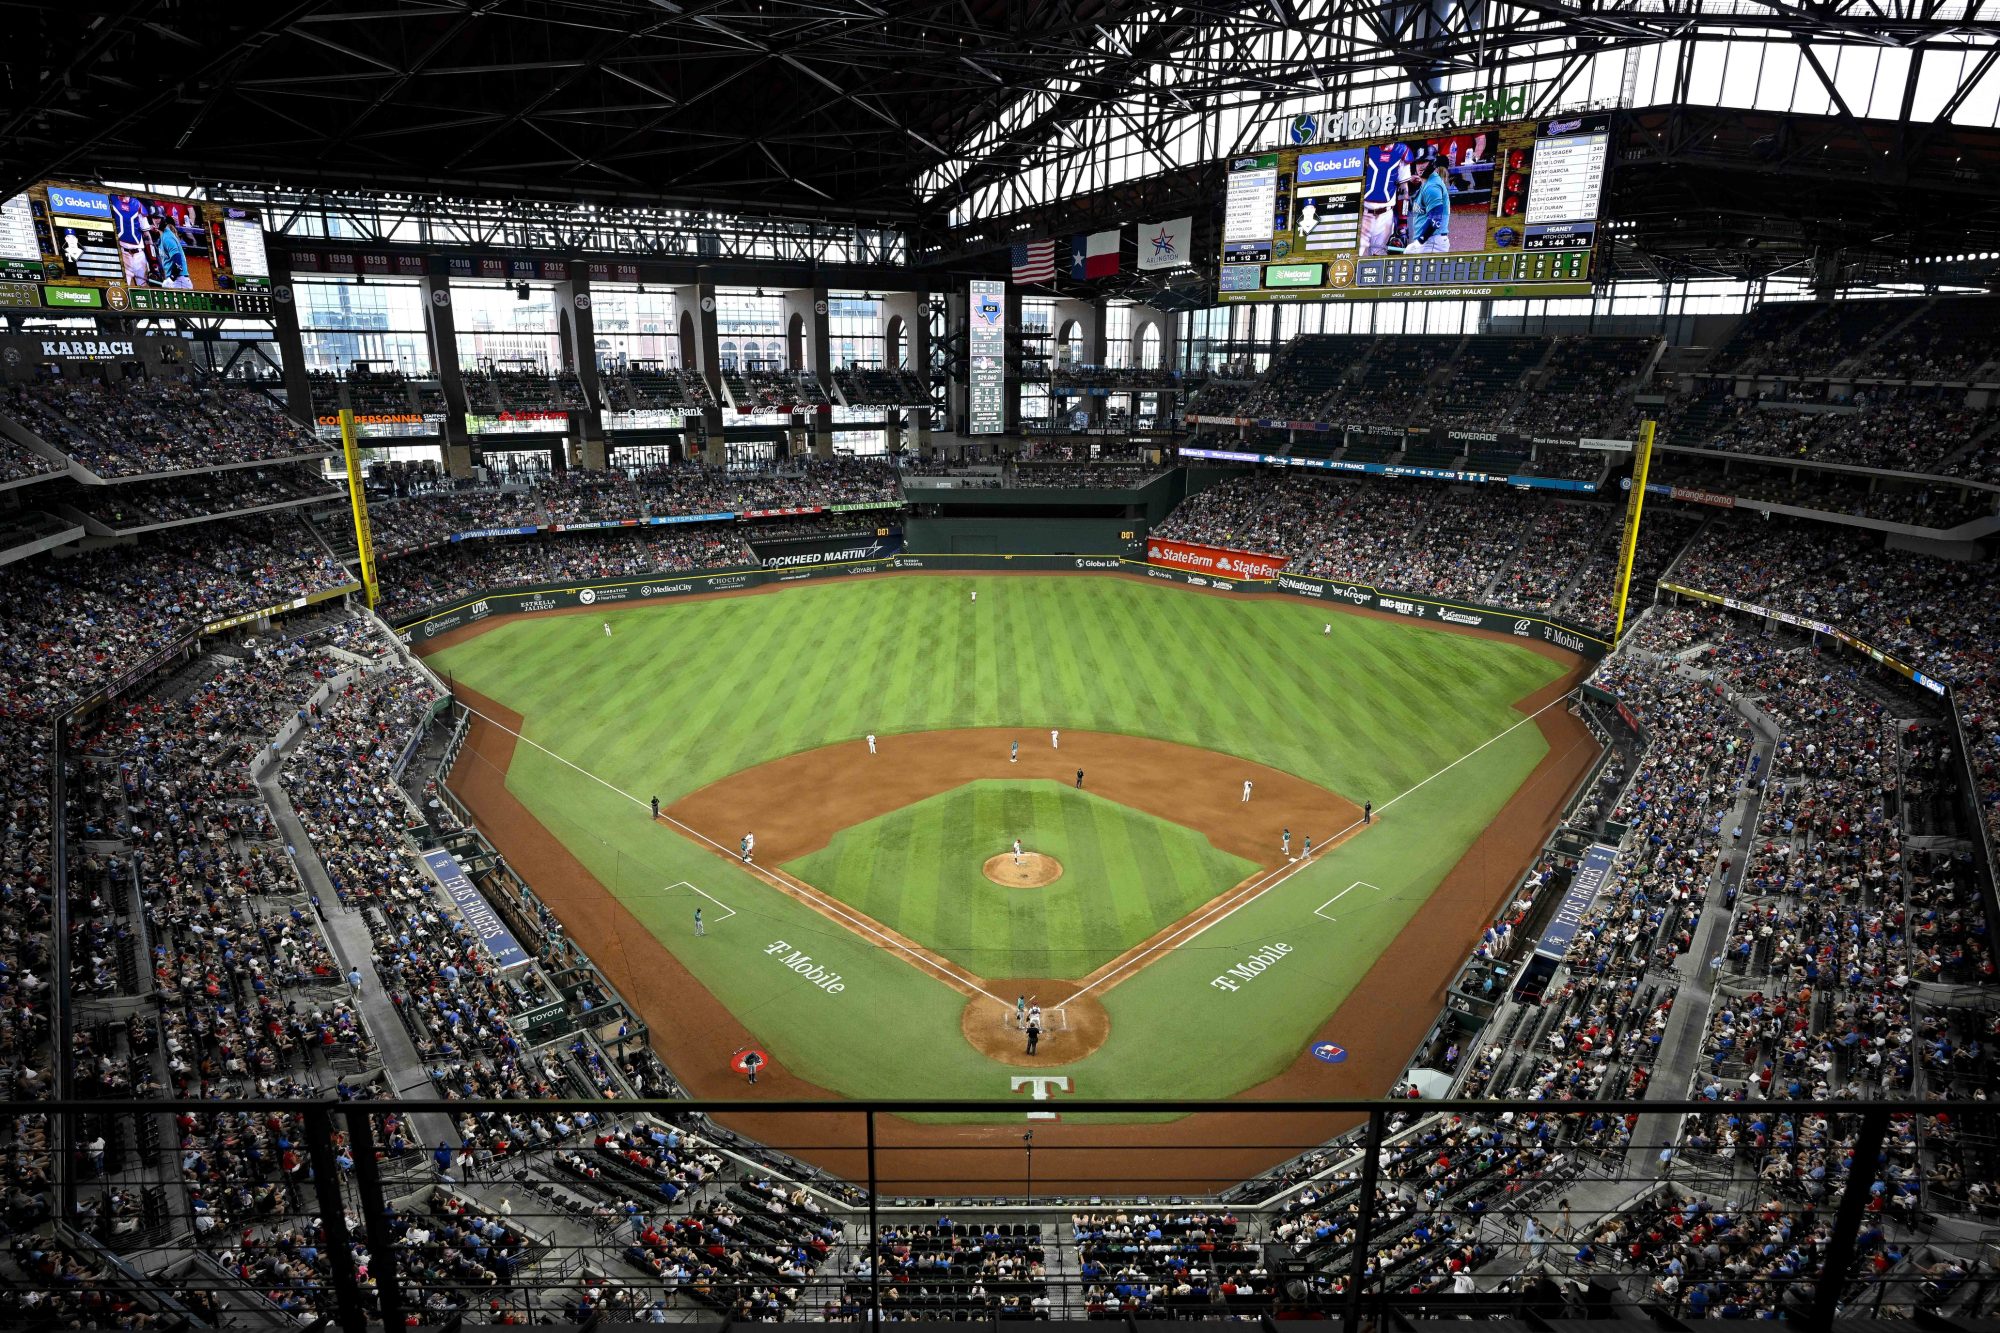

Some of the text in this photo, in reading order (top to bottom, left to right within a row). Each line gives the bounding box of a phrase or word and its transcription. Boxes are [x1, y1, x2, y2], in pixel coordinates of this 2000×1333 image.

[1324, 85, 1526, 139] Globe Life Field
[1314, 157, 1362, 172] Globe Life
[64, 197, 108, 210] Globe Life
[329, 254, 353, 264] 1998
[363, 255, 387, 265] 1999
[399, 256, 421, 266] 2010
[449, 258, 471, 268] 2010
[1146, 254, 1179, 263] ARLINGTON
[483, 259, 502, 269] 2011
[513, 261, 533, 270] 2011
[544, 262, 564, 271] 2012
[589, 263, 609, 273] 2015
[617, 264, 636, 274] 2016
[1283, 269, 1312, 278] National
[1363, 267, 1377, 275] SEA
[63, 291, 91, 300] National
[274, 289, 290, 300] 42
[1424, 288, 1456, 296] CRAWFORD
[1456, 287, 1491, 295] WALKED
[434, 293, 448, 303] 34
[576, 297, 589, 306] 26
[705, 301, 711, 309] 7
[816, 303, 827, 312] 29
[920, 306, 927, 314] 10
[41, 341, 135, 356] KARBACH
[677, 407, 704, 416] Bank
[855, 404, 899, 412] CHOCTAW
[354, 414, 423, 424] PERSONNEL
[1270, 420, 1287, 428] 105.3
[1448, 431, 1498, 441] POWERADE
[1677, 488, 1732, 506] orange.promo
[865, 501, 901, 509] STAFFING
[667, 515, 704, 523] NETSPEND
[566, 522, 601, 530] GARDENERS
[762, 549, 866, 567] LOCKHEED MARTIN
[847, 566, 877, 575] VERYABLE
[710, 576, 746, 585] CHOCTAW
[652, 583, 692, 594] Medical City
[1288, 579, 1323, 593] National
[1343, 586, 1372, 605] Kroger
[472, 600, 489, 614] UTA
[520, 599, 556, 608] ESTRELLA
[524, 604, 554, 612] JALISCO
[1395, 601, 1414, 612] BITE
[1450, 611, 1483, 623] Germania
[1553, 630, 1584, 652] Mobile
[1555, 866, 1603, 927] TEXAS RANGERS
[444, 874, 504, 939] TEXAS RANGERS
[1226, 942, 1293, 982] Mobile
[778, 950, 845, 994] Mobile
[530, 1007, 564, 1023] TOYOTA
[1011, 1076, 1069, 1119] T
